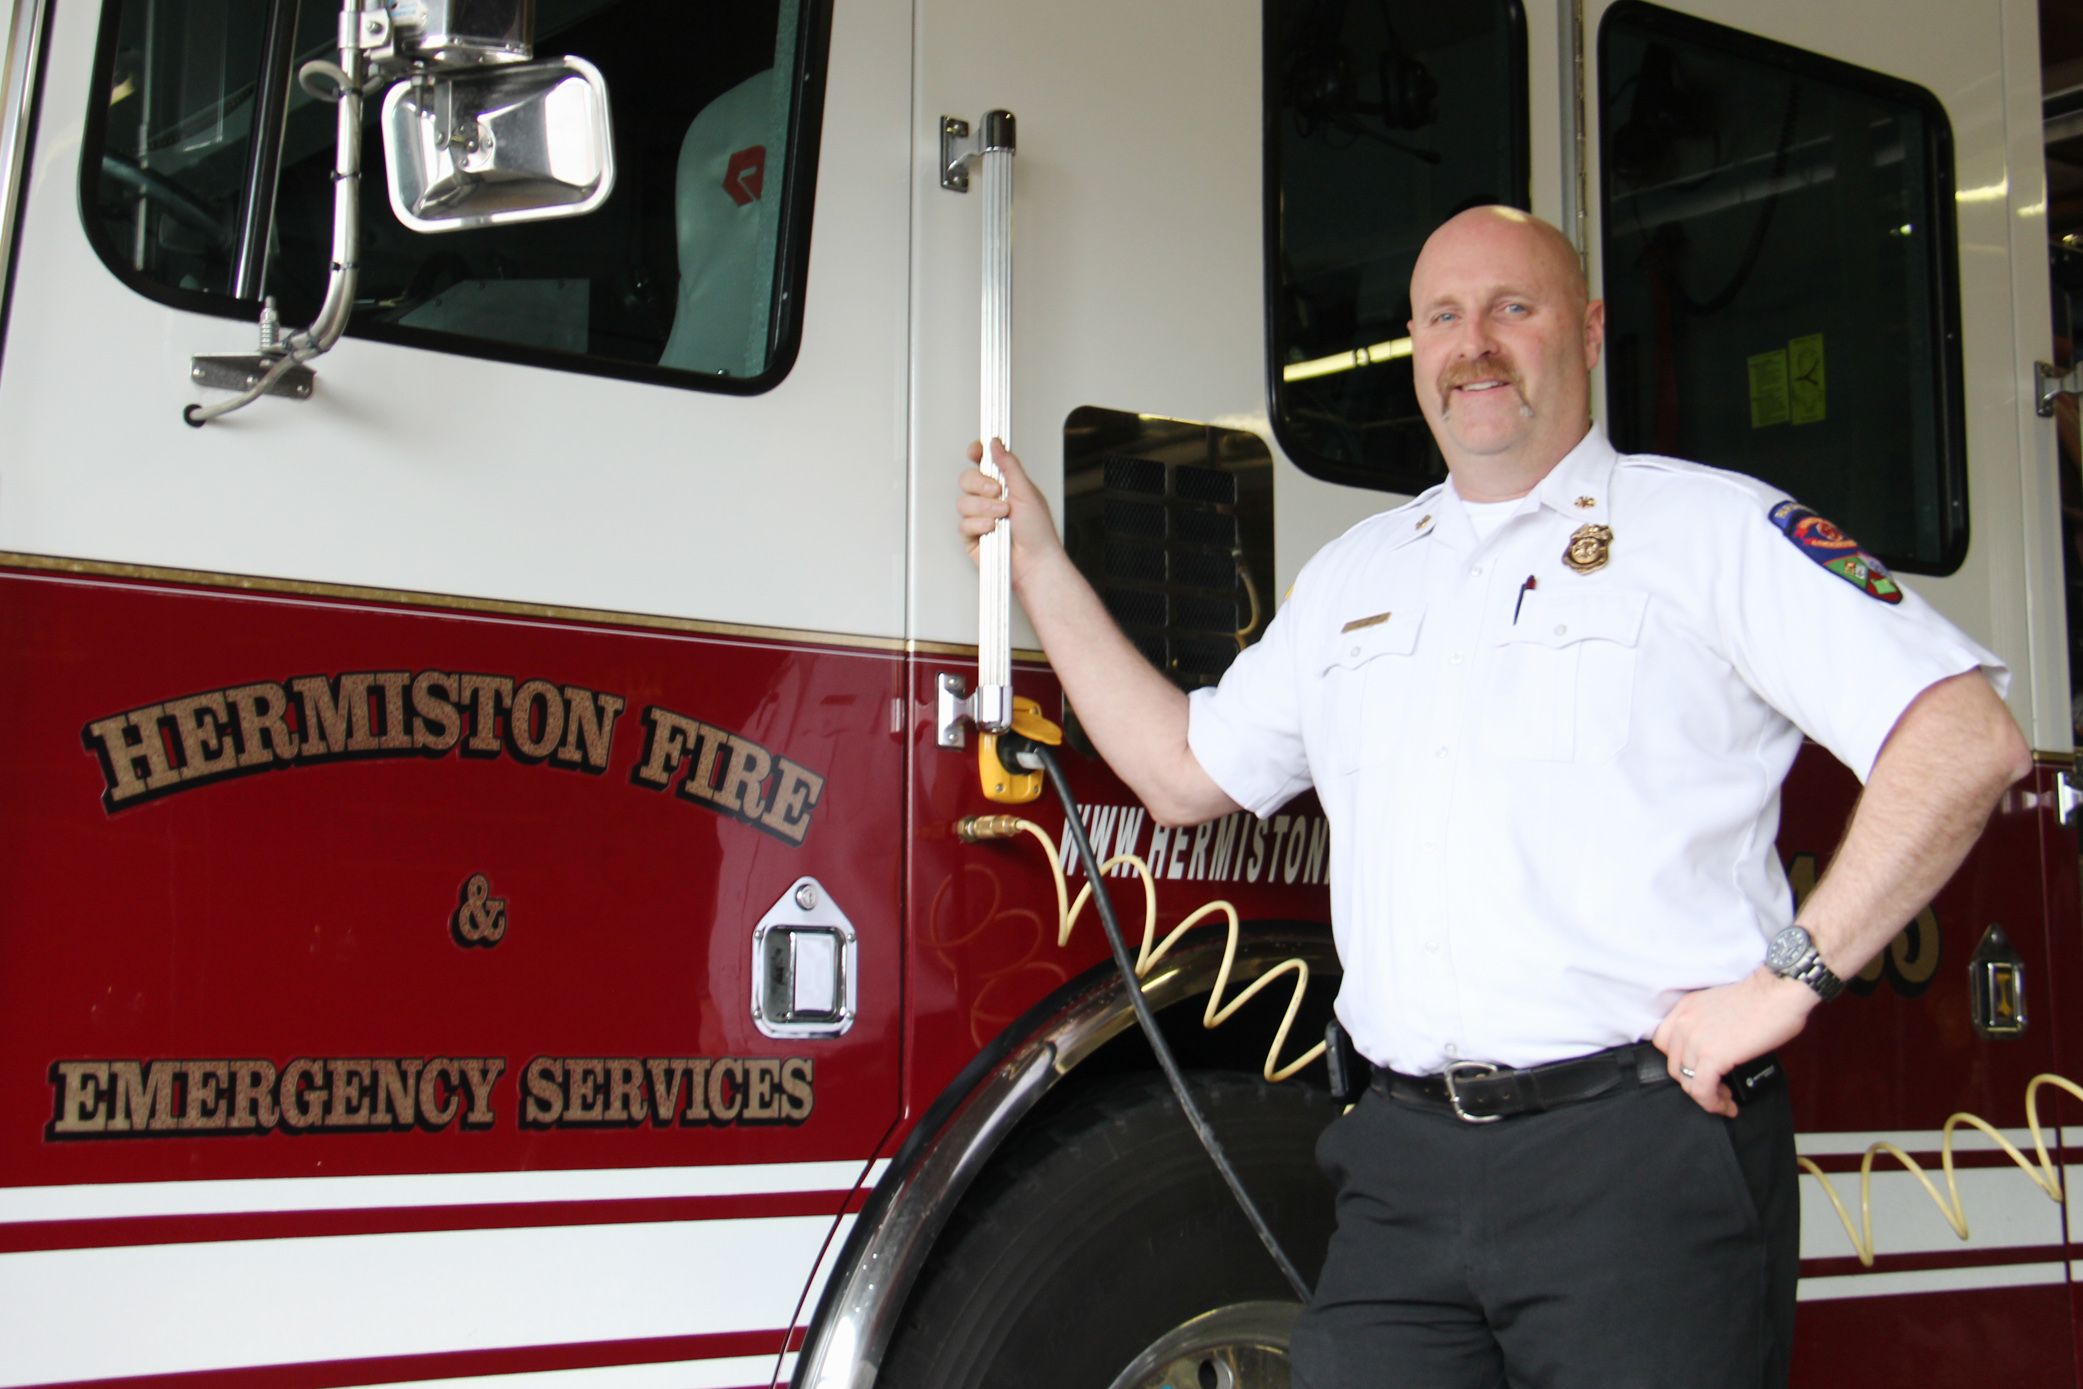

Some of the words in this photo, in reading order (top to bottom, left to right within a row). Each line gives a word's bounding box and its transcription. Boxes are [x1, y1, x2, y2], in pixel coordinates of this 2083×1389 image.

[84, 669, 624, 812] HERMISTON
[632, 705, 825, 846] FIRE
[1058, 803, 1330, 885] WWW.HERMISTON
[452, 872, 507, 947] &
[46, 1057, 506, 1141] EMERGENCY
[519, 1055, 815, 1131] SERVICES
